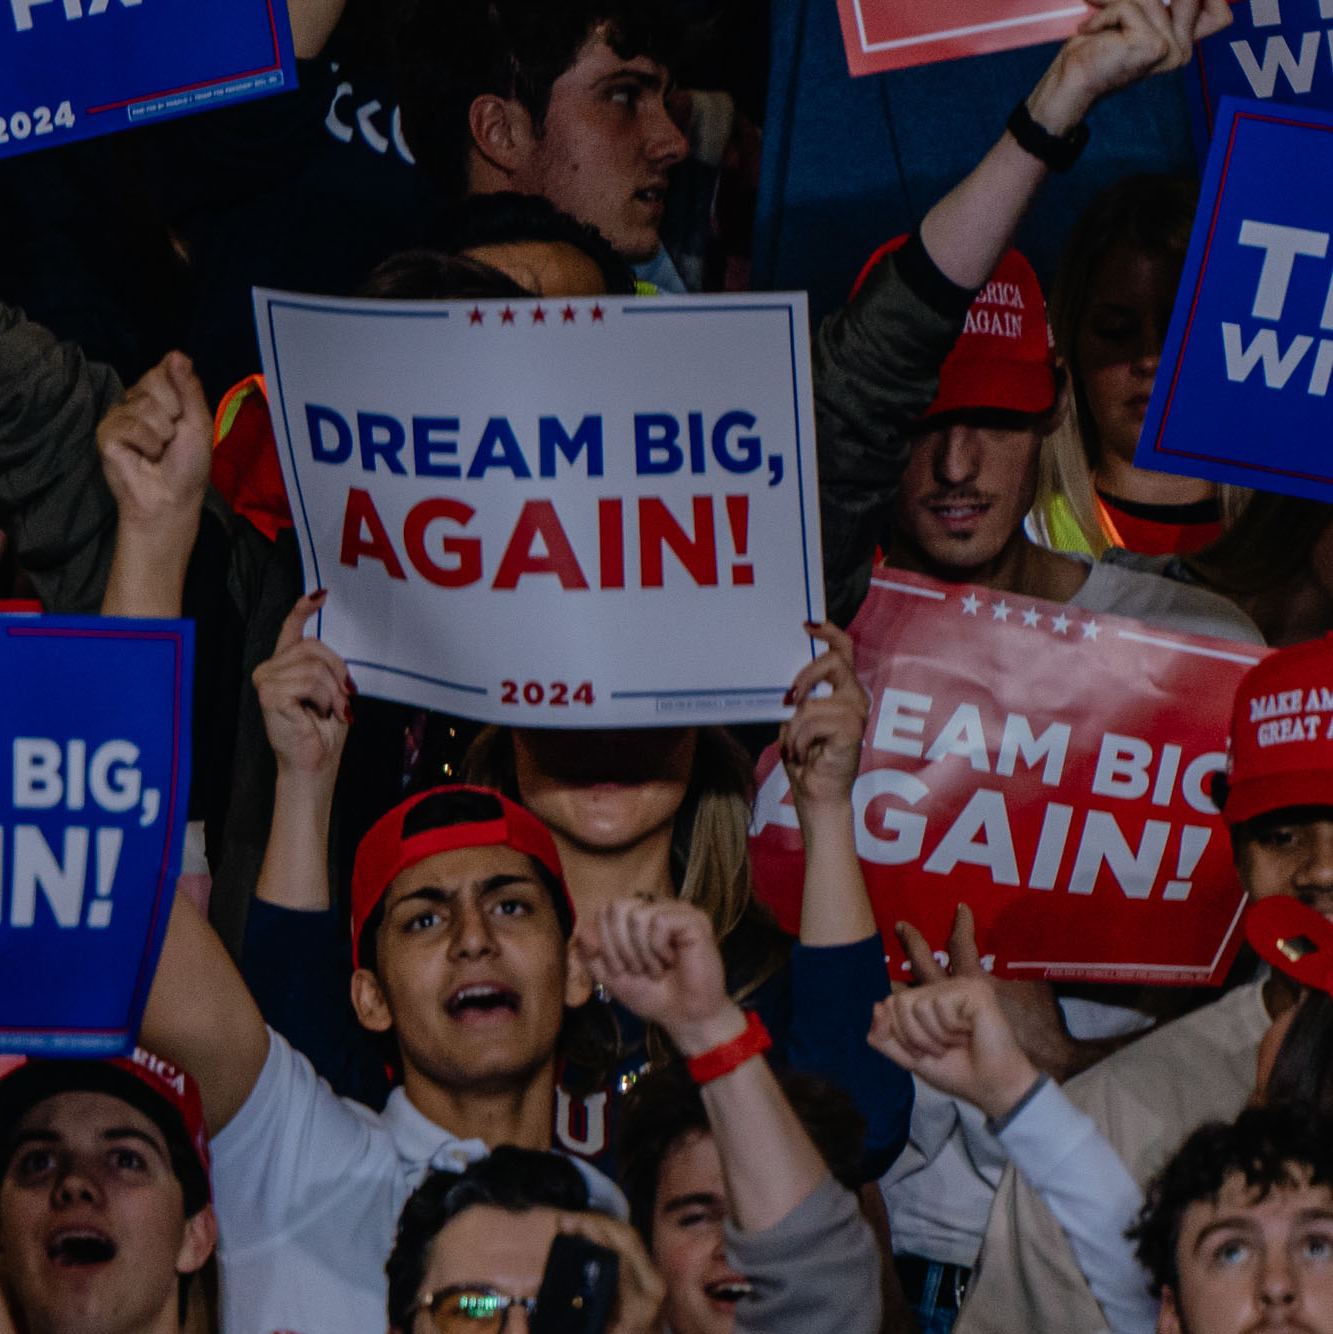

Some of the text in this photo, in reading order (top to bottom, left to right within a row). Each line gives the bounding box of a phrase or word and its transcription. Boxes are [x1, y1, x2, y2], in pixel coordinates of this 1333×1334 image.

[963, 309, 1023, 339] AGAIN
[304, 402, 784, 486] DREAM BIG,
[339, 486, 755, 592] AGAIN!
[500, 680, 596, 706] 2024
[1249, 688, 1304, 723] MAKE
[871, 688, 1230, 815] EAM BIG
[1256, 714, 1322, 748] GREAT
[11, 738, 160, 826] BIG,
[133, 1046, 186, 1097] RICA
